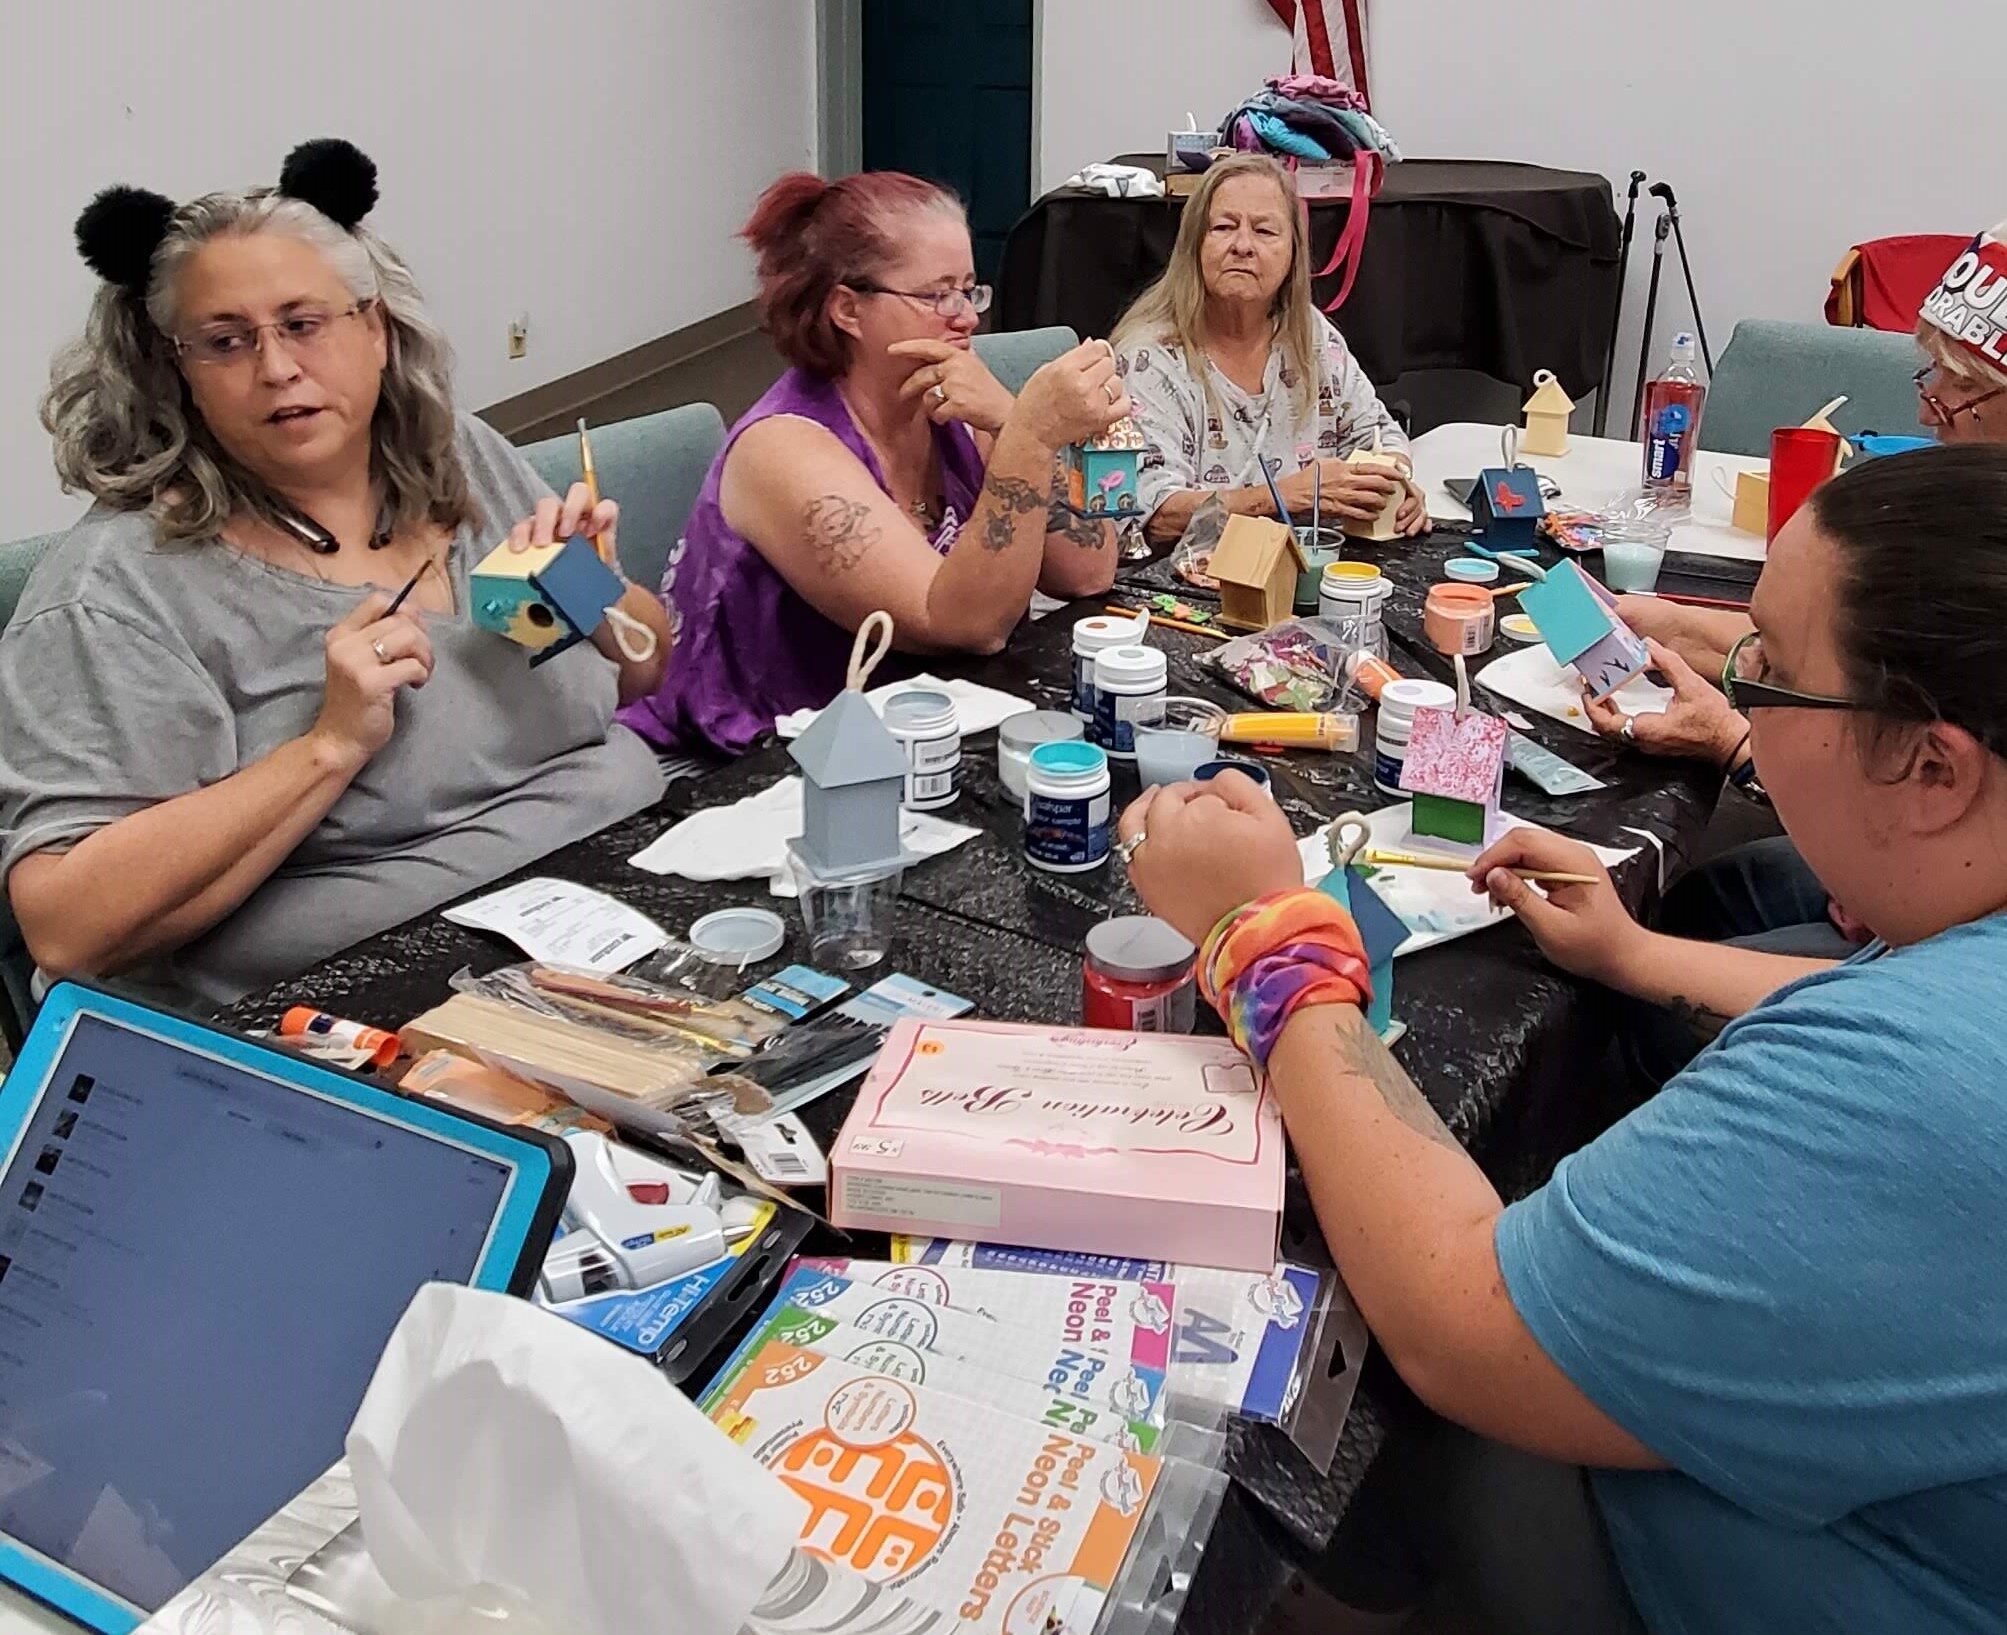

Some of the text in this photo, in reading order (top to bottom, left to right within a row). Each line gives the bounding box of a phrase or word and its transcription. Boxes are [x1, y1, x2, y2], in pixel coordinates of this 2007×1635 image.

[1652, 439, 1666, 479] smart
[921, 1084, 1235, 1137] Celebration Bells
[1062, 1282, 1096, 1342] Neon
[1094, 1285, 1118, 1323] Peel
[1070, 1357, 1106, 1401] Peel
[1058, 1443, 1096, 1491] Peel
[959, 1434, 1074, 1621] Neon Letters
[1017, 1517, 1061, 1574] Stick
